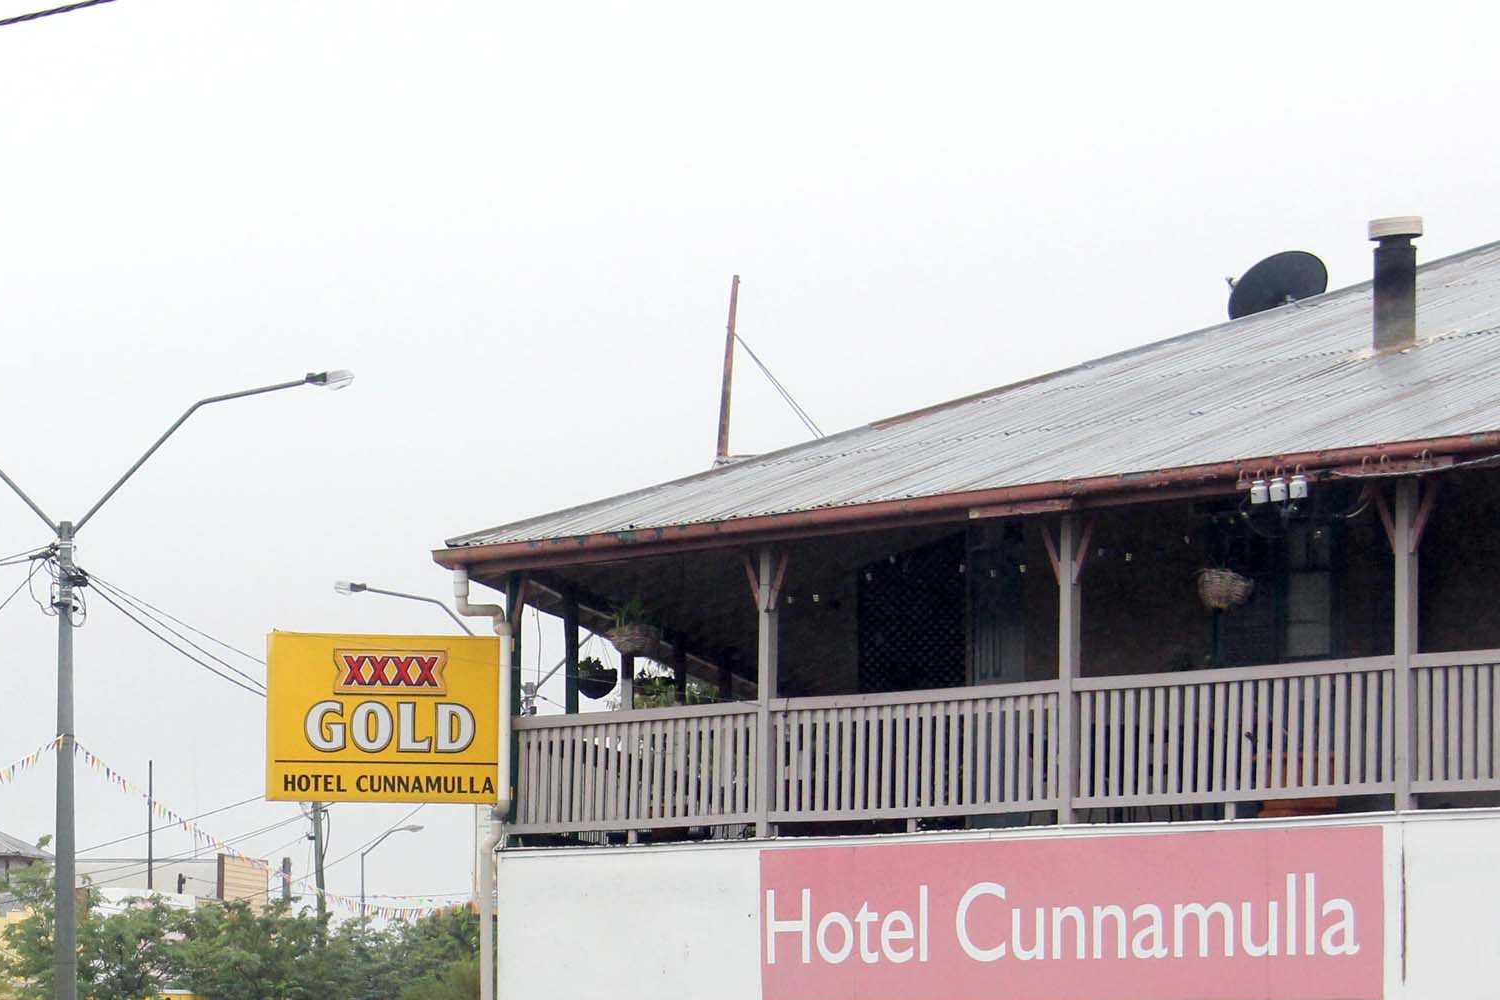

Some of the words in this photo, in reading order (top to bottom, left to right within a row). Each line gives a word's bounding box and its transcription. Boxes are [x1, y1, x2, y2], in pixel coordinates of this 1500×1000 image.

[342, 654, 439, 688] XXXX
[303, 699, 476, 754] GOLD
[283, 774, 347, 793] HOTEL
[356, 775, 495, 794] CUNNAMULLA
[765, 884, 929, 965] Hotel
[955, 872, 1361, 963] Cunnamulla
